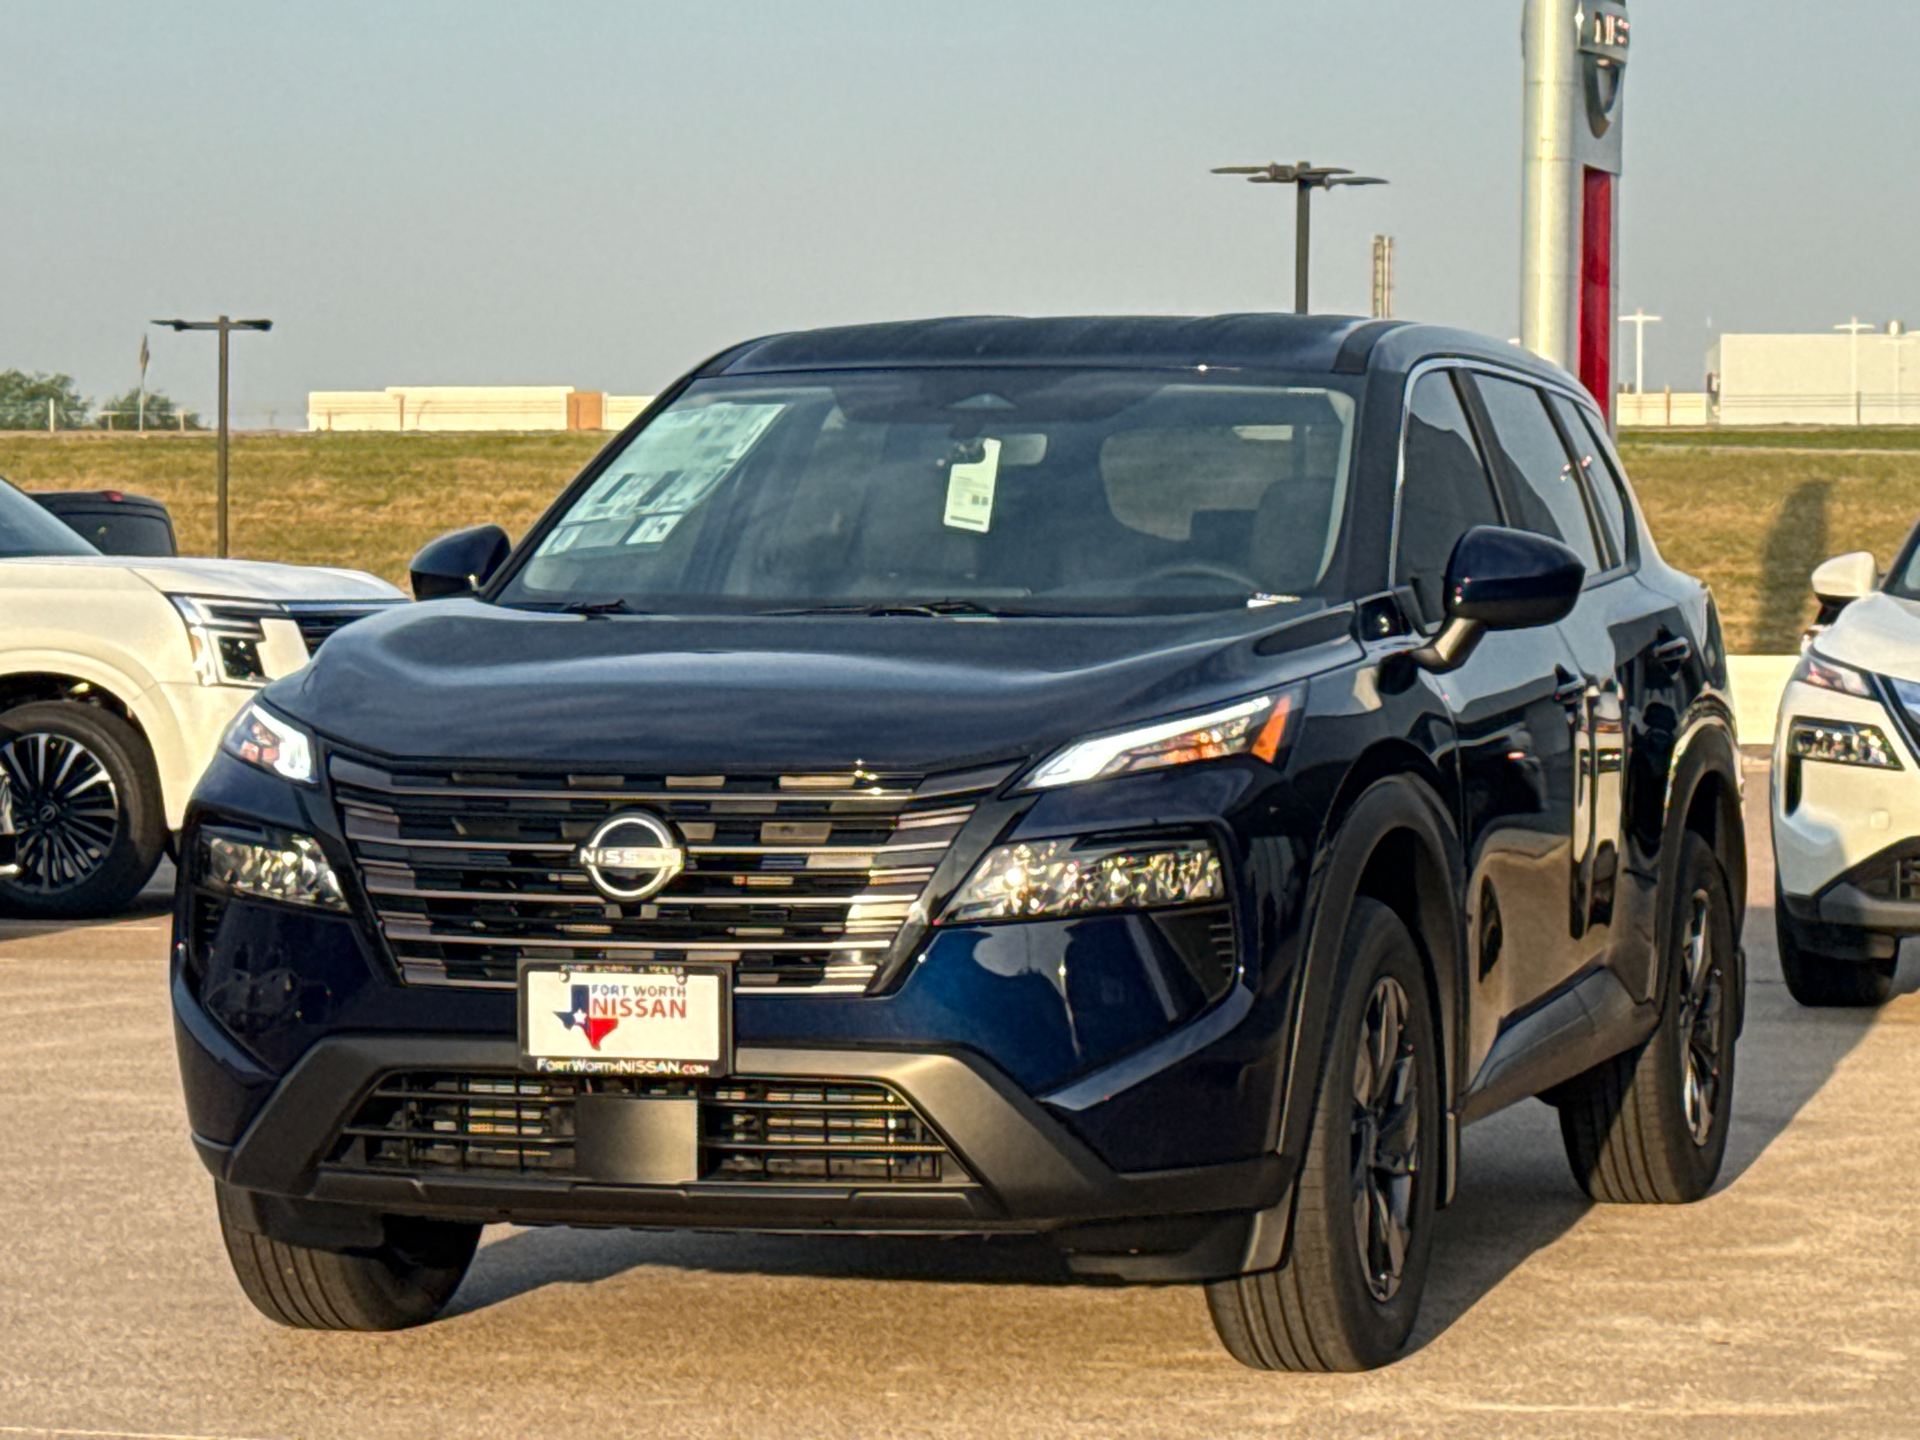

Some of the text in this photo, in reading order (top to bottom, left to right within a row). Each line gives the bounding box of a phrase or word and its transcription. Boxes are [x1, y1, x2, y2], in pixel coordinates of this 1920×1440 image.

[591, 985, 687, 998] FORT WORTH
[591, 998, 687, 1018] NISSAN
